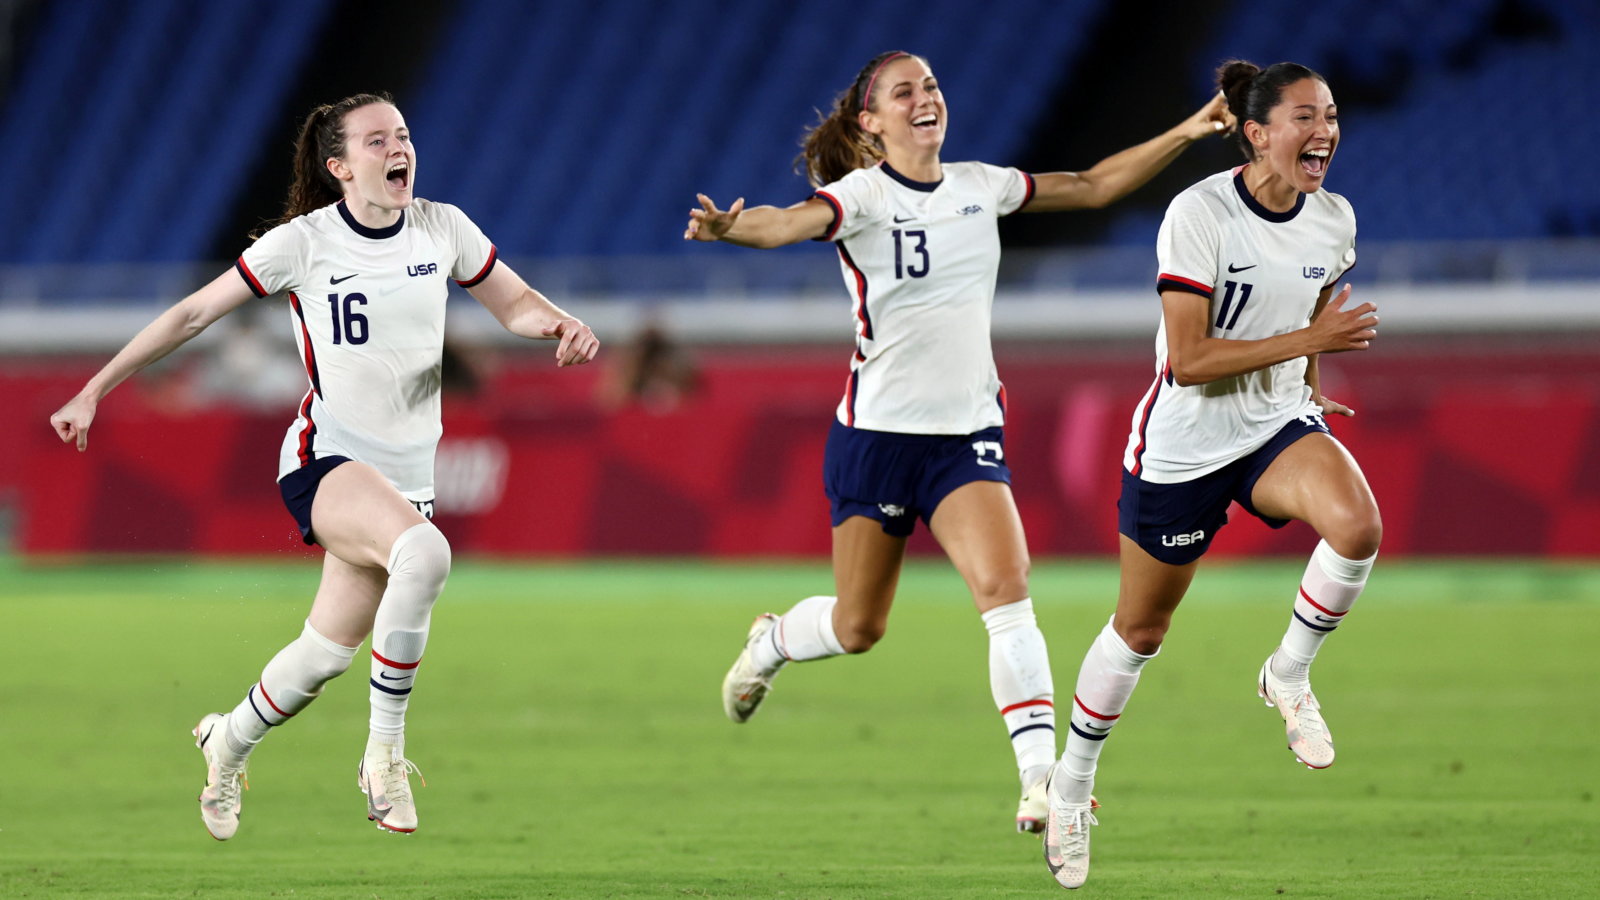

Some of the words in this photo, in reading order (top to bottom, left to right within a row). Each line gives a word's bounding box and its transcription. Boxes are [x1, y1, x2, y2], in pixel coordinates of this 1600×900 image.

[407, 263, 438, 278] USA
[892, 229, 930, 279] 13
[1303, 266, 1326, 279] USA
[328, 292, 369, 345] 16
[1215, 280, 1253, 330] 11
[1162, 529, 1205, 547] USA
